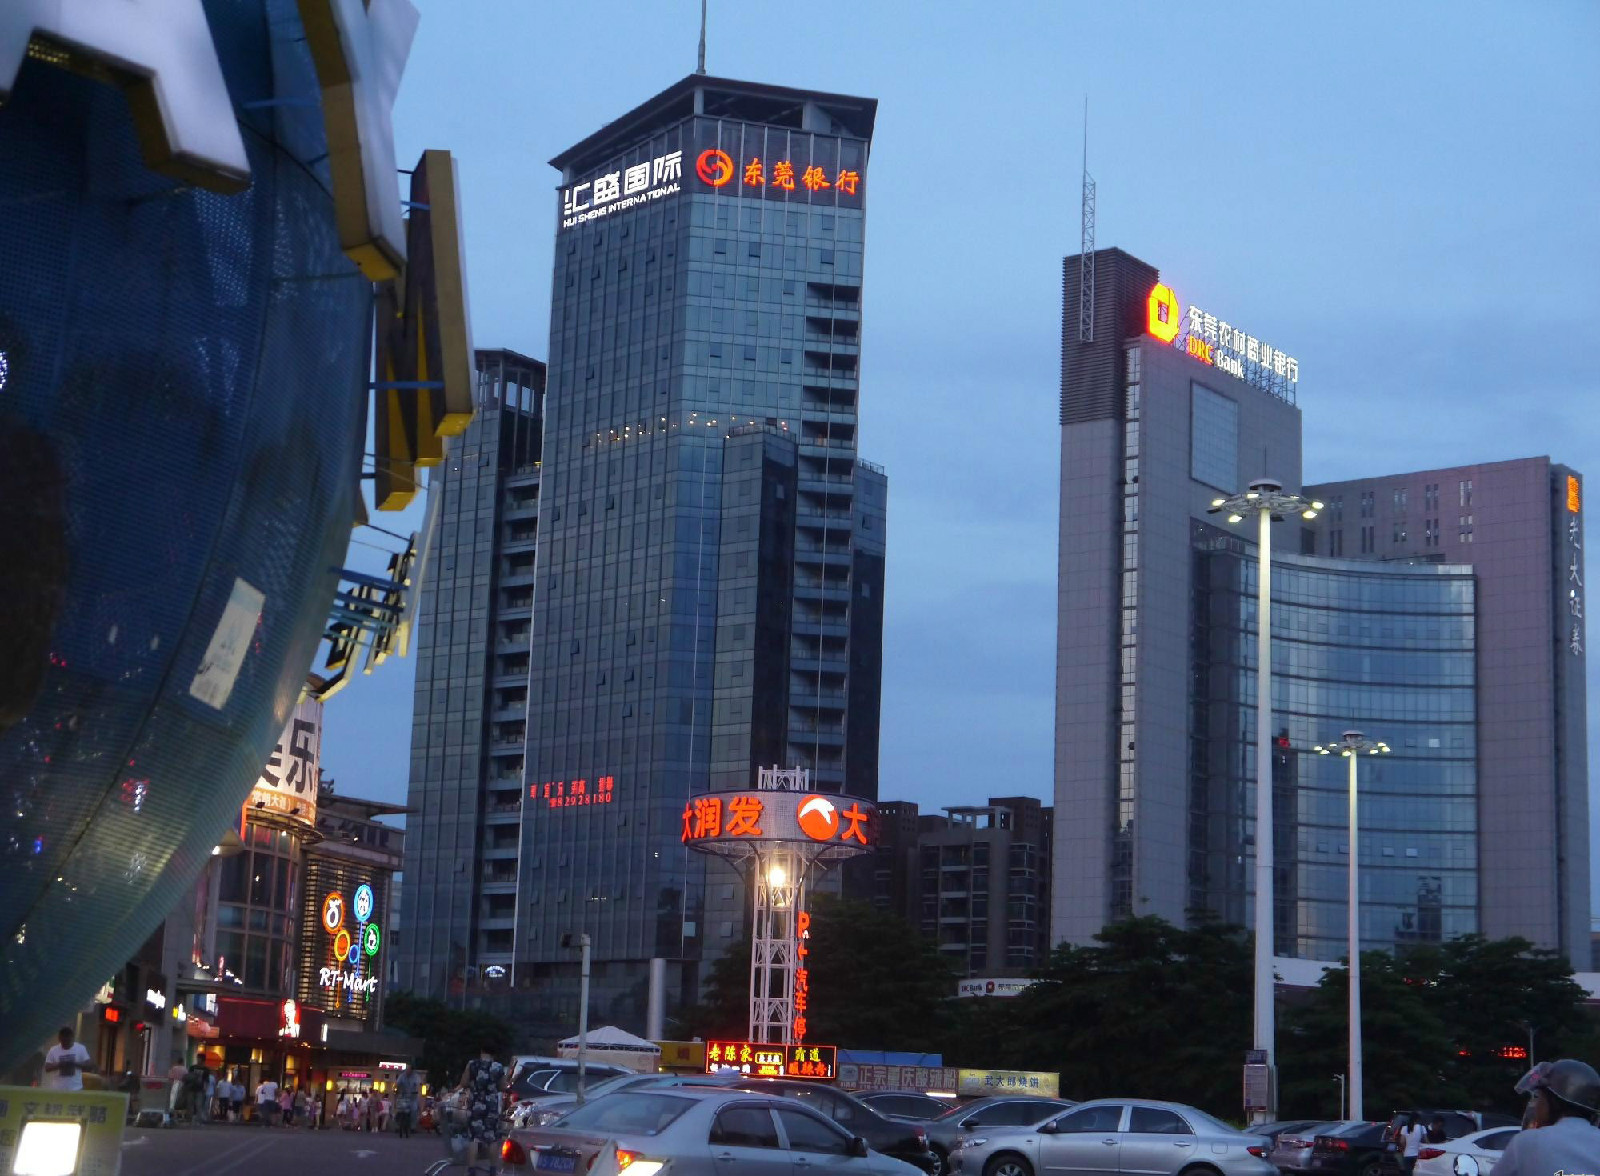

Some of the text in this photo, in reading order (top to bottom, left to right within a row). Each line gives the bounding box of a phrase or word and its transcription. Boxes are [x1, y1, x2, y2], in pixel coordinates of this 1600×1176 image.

[563, 150, 682, 215] 汇盛国际
[743, 157, 860, 194] 东莞银行
[563, 183, 681, 228] HUI SHENG INTERNATIONAL
[1188, 335, 1245, 379] DRC Bank
[1189, 305, 1299, 382] 东莞农村商业银行
[681, 796, 764, 843] 大润发
[319, 967, 379, 993] RT-Mart
[858, 1065, 957, 1089] 正宗重庆酸辣粉
